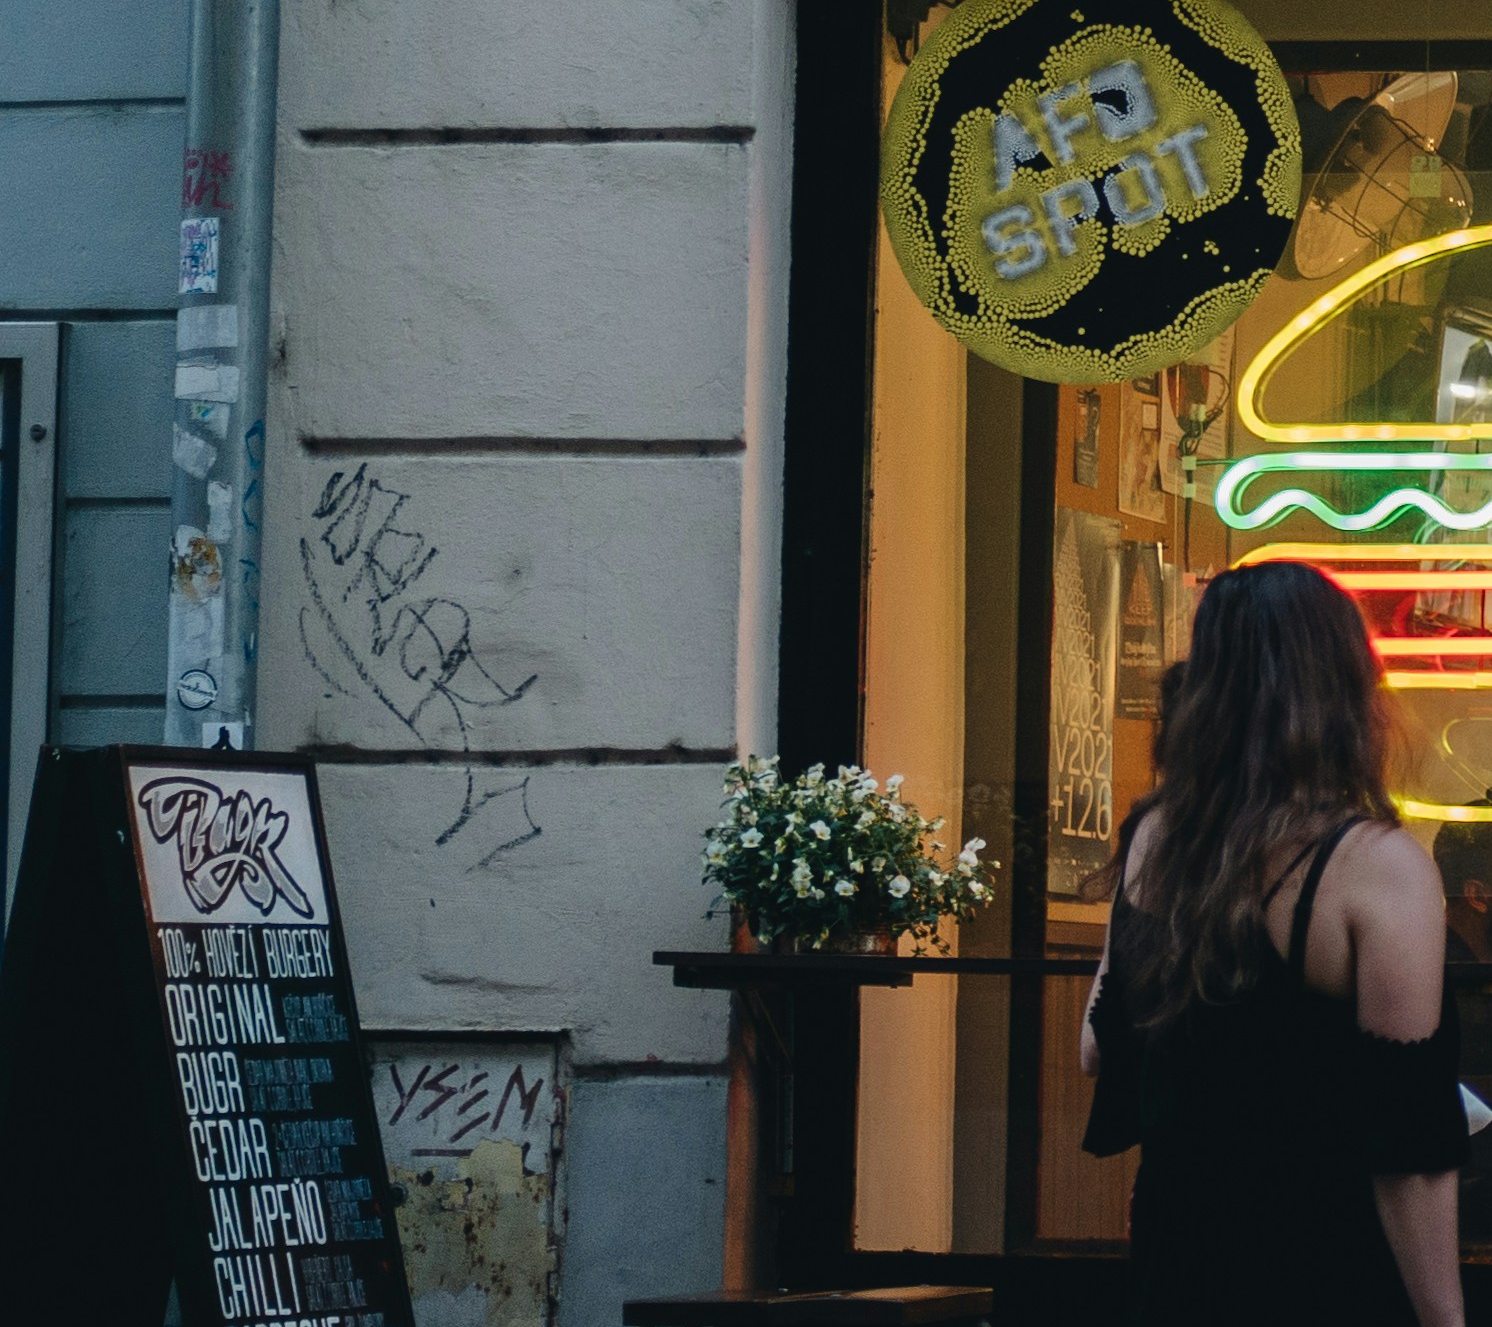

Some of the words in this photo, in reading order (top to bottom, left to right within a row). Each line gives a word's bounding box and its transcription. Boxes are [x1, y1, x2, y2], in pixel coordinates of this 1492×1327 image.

[981, 123, 1209, 281] SPOT
[156, 927, 201, 978] 100%
[202, 924, 260, 979] HOVĚZÍ
[262, 928, 335, 979] BURGERY
[164, 983, 287, 1047] ORIGINAL
[176, 1051, 246, 1116] BUGR
[188, 1114, 273, 1182] ČEDAR
[208, 1177, 328, 1252] JALAPEŇO
[213, 1251, 301, 1320] CHILLI
